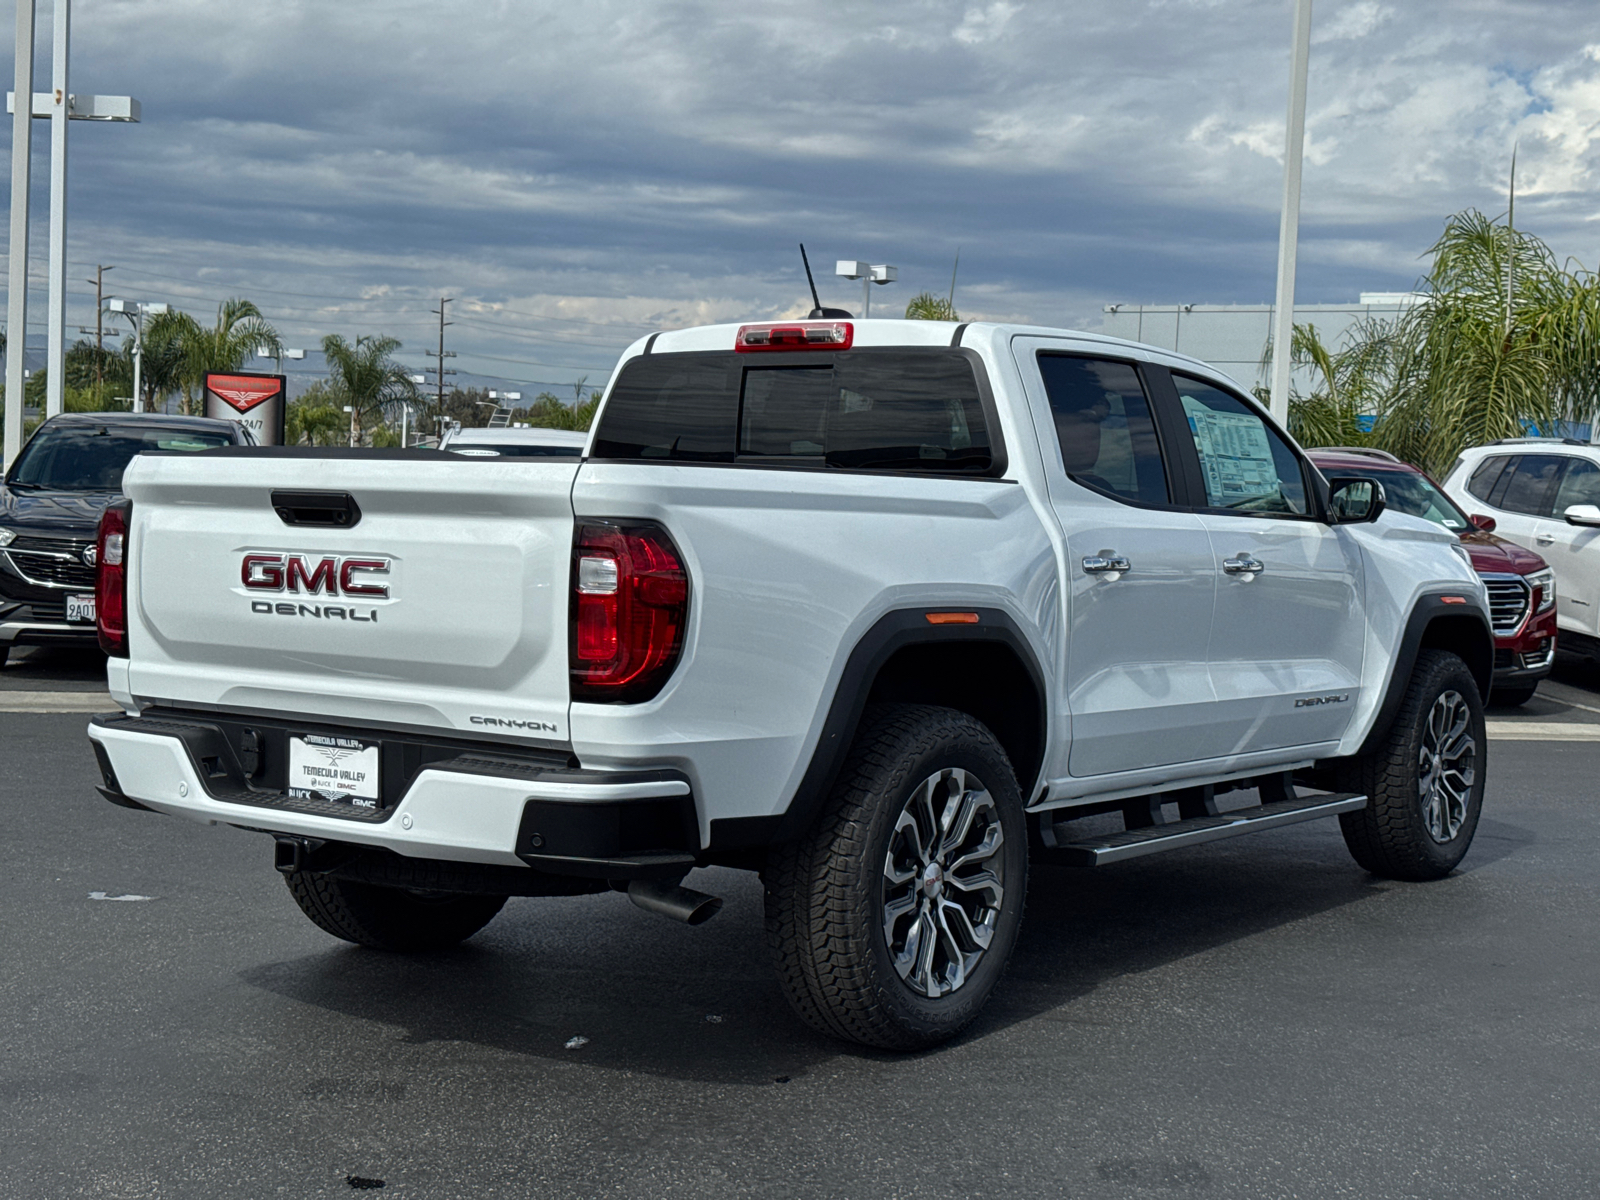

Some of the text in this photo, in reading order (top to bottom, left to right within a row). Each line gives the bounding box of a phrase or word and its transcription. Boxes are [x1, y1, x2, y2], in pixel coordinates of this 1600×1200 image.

[241, 553, 391, 599] GMC
[251, 600, 378, 623] DENALI
[1294, 693, 1349, 708] DENALI
[469, 716, 557, 733] CANYON
[307, 735, 359, 748] TEMECULA VALLEY
[303, 765, 366, 782] TEMECULA VALLEY
[353, 798, 377, 809] GMC
[926, 873, 942, 887] GMC
